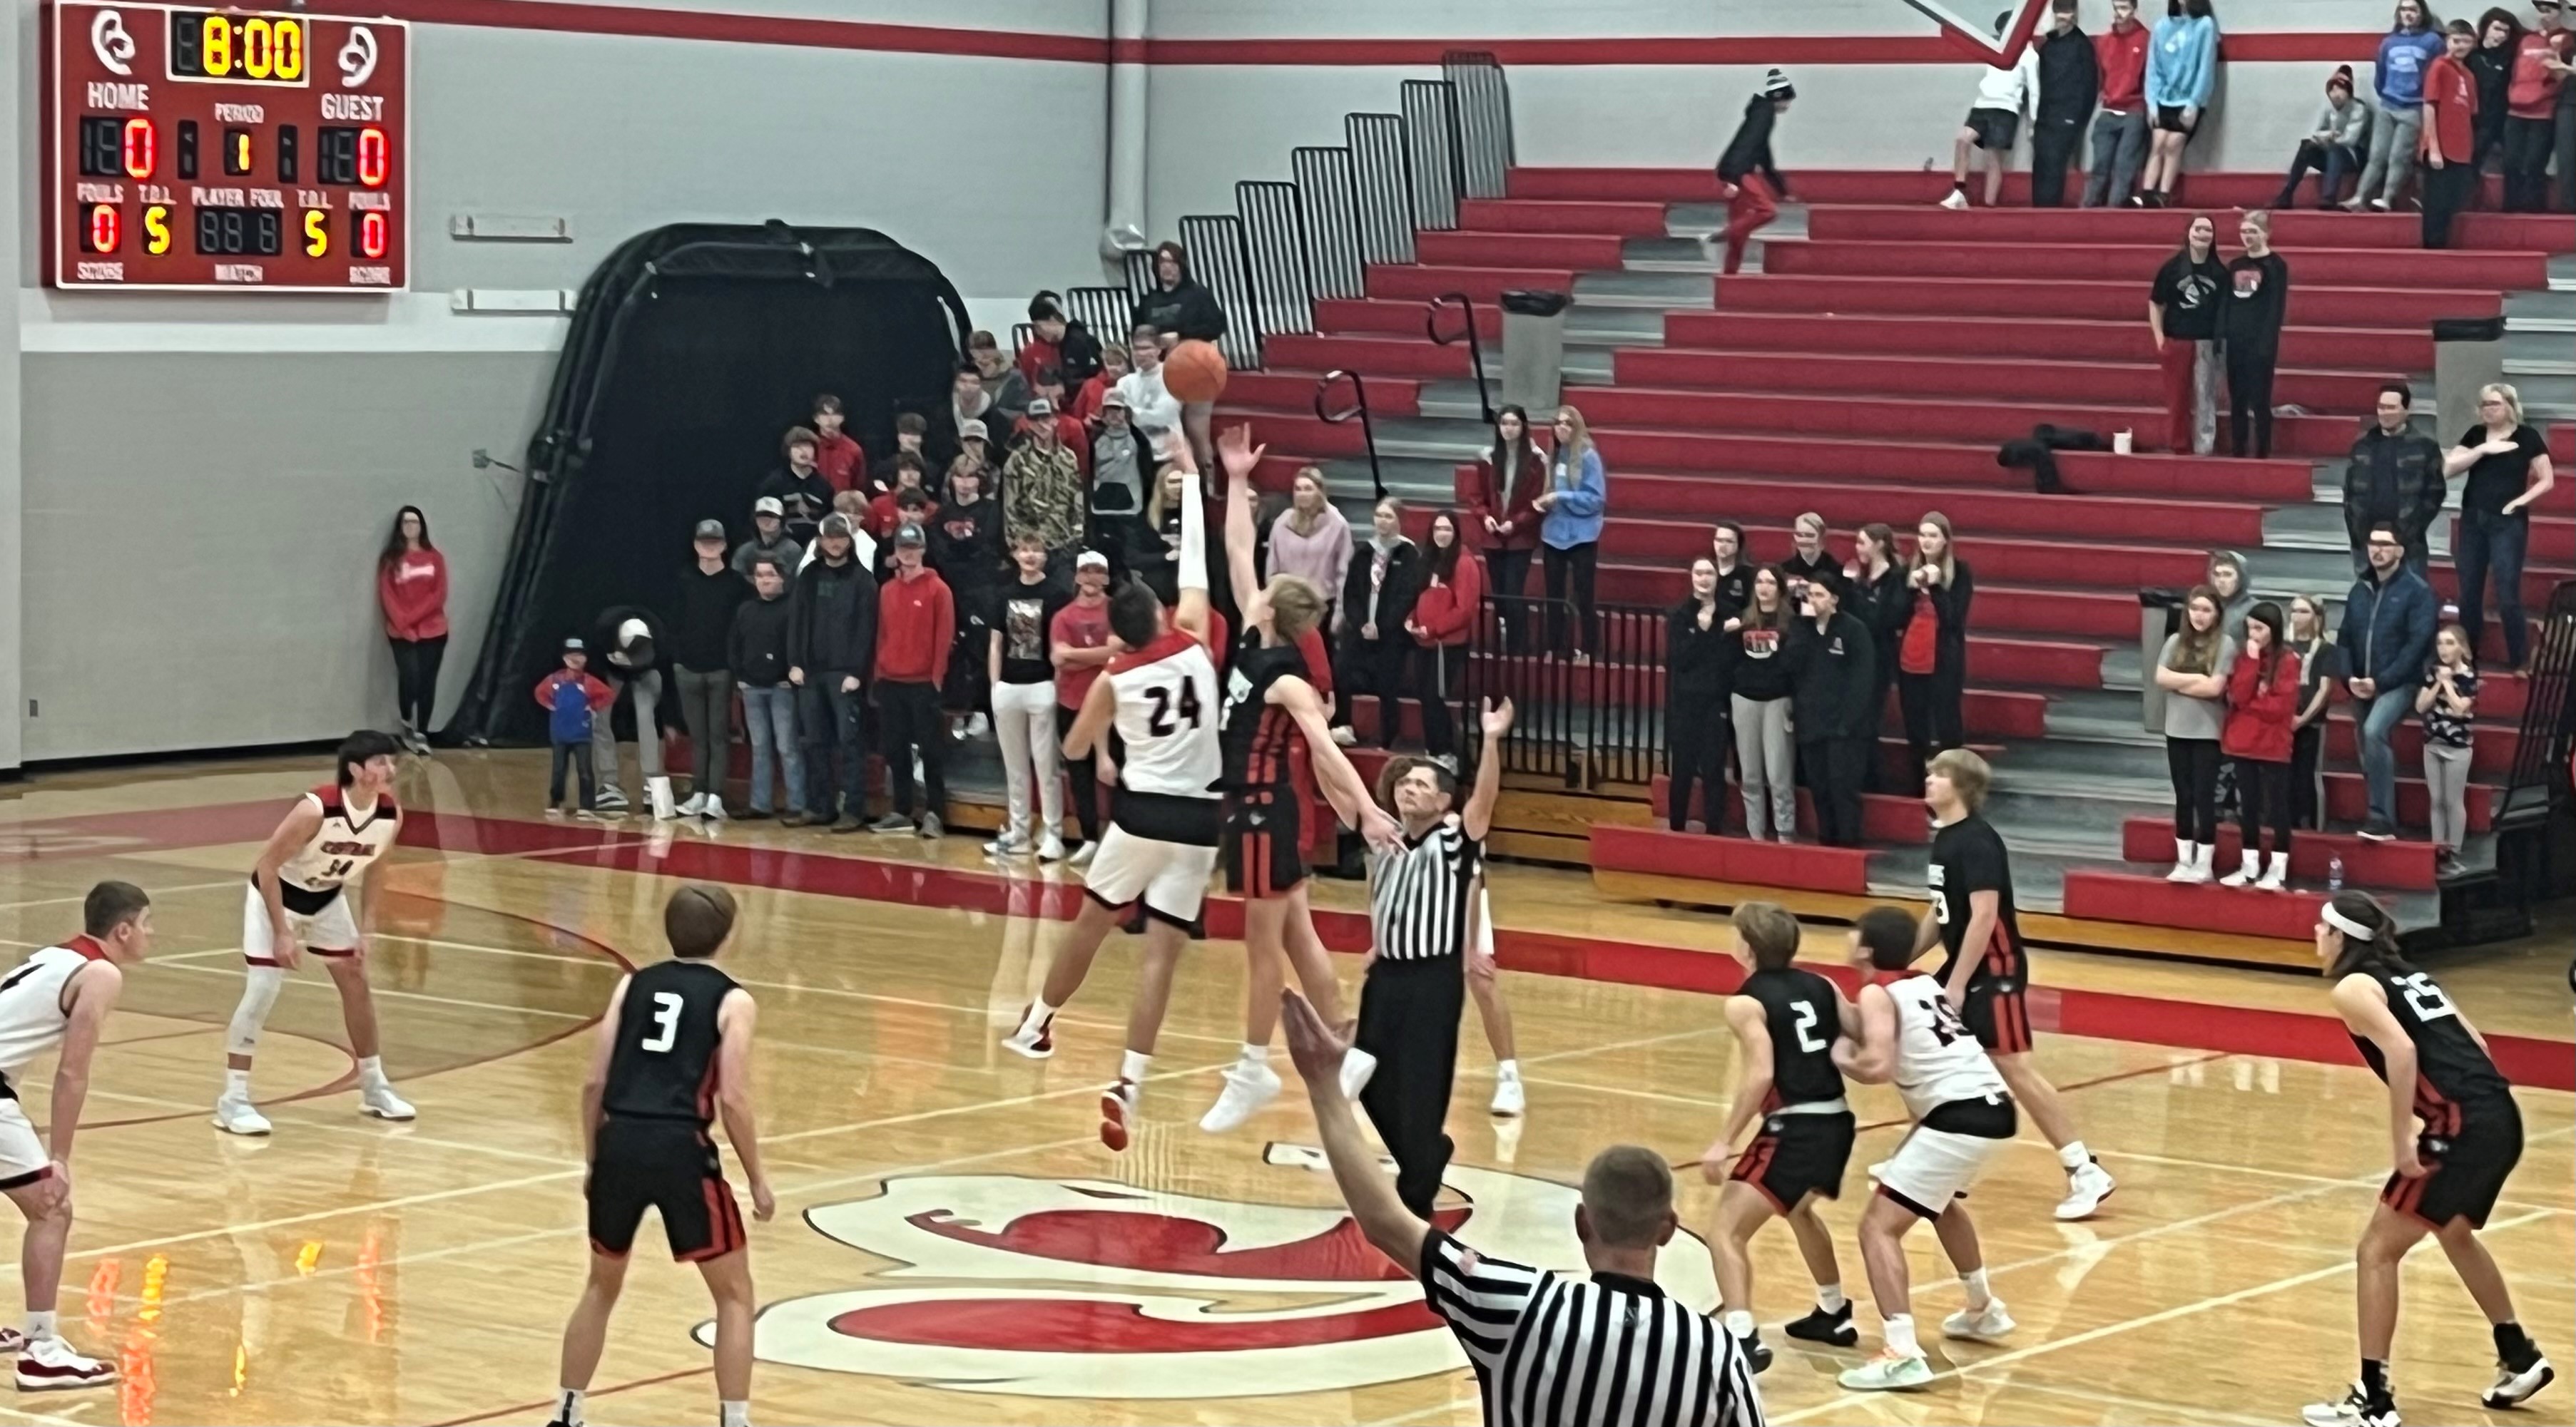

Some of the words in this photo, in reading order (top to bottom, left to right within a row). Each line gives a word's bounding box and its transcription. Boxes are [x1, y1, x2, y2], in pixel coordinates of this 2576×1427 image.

[203, 16, 301, 79] 8:00
[88, 82, 149, 111] HOME
[215, 103, 265, 123] PERIOD
[321, 93, 385, 121] GUEST
[125, 118, 155, 178] 0
[239, 133, 250, 170] 1
[360, 128, 387, 185] 0
[77, 183, 124, 203] FOULS
[191, 186, 245, 208] PLAYER
[93, 205, 116, 252] 0
[363, 213, 385, 257] 0
[1144, 675, 1201, 737] 24
[2390, 971, 2455, 1023] 25
[641, 991, 684, 1053] 3
[1789, 1000, 1827, 1053] 2
